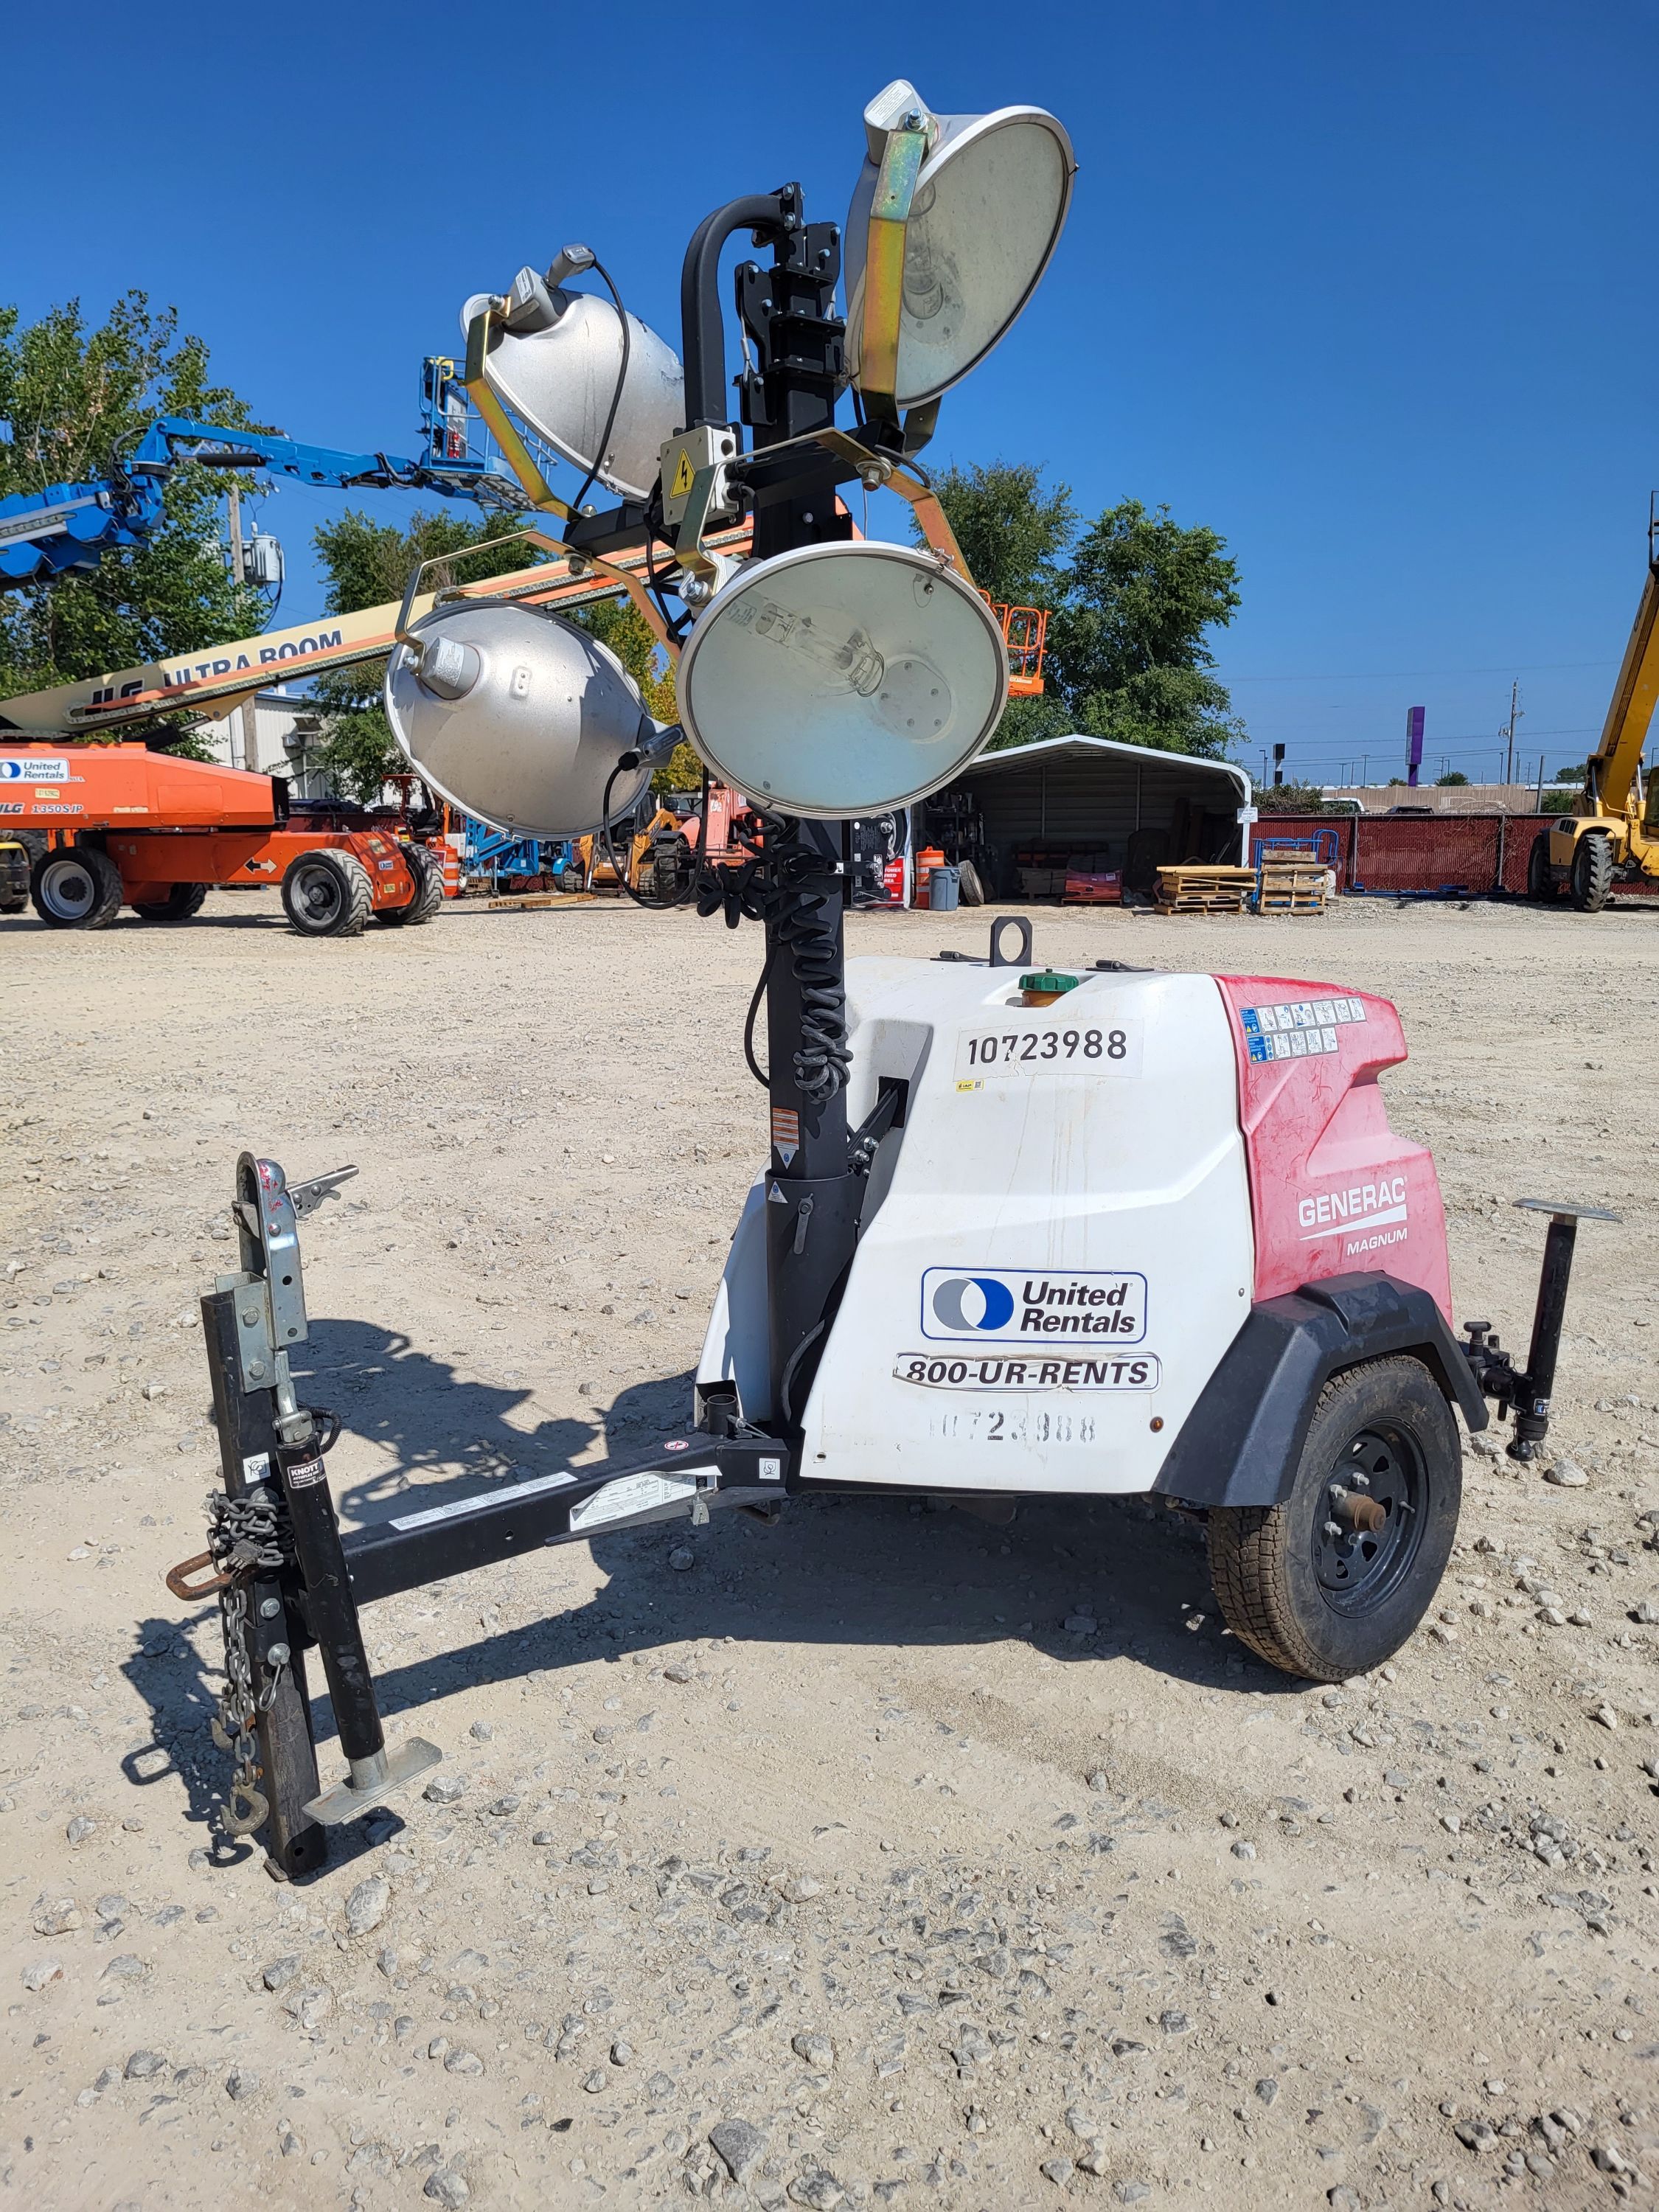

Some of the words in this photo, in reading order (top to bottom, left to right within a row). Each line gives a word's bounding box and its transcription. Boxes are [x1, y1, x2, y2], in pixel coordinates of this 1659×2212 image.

[162, 653, 251, 687] ULTRA
[260, 629, 343, 664] BOOM
[24, 762, 60, 771] United
[24, 771, 64, 779] Rentals
[968, 1029, 1127, 1065] 10723988
[1298, 1177, 1406, 1228] GENERAC
[1346, 1228, 1408, 1256] MAGNUM
[1022, 1281, 1129, 1307] United
[1020, 1308, 1135, 1333] Rentals
[905, 1360, 1149, 1385] 800-UR-RENTS
[291, 1462, 319, 1477] KNOTT
